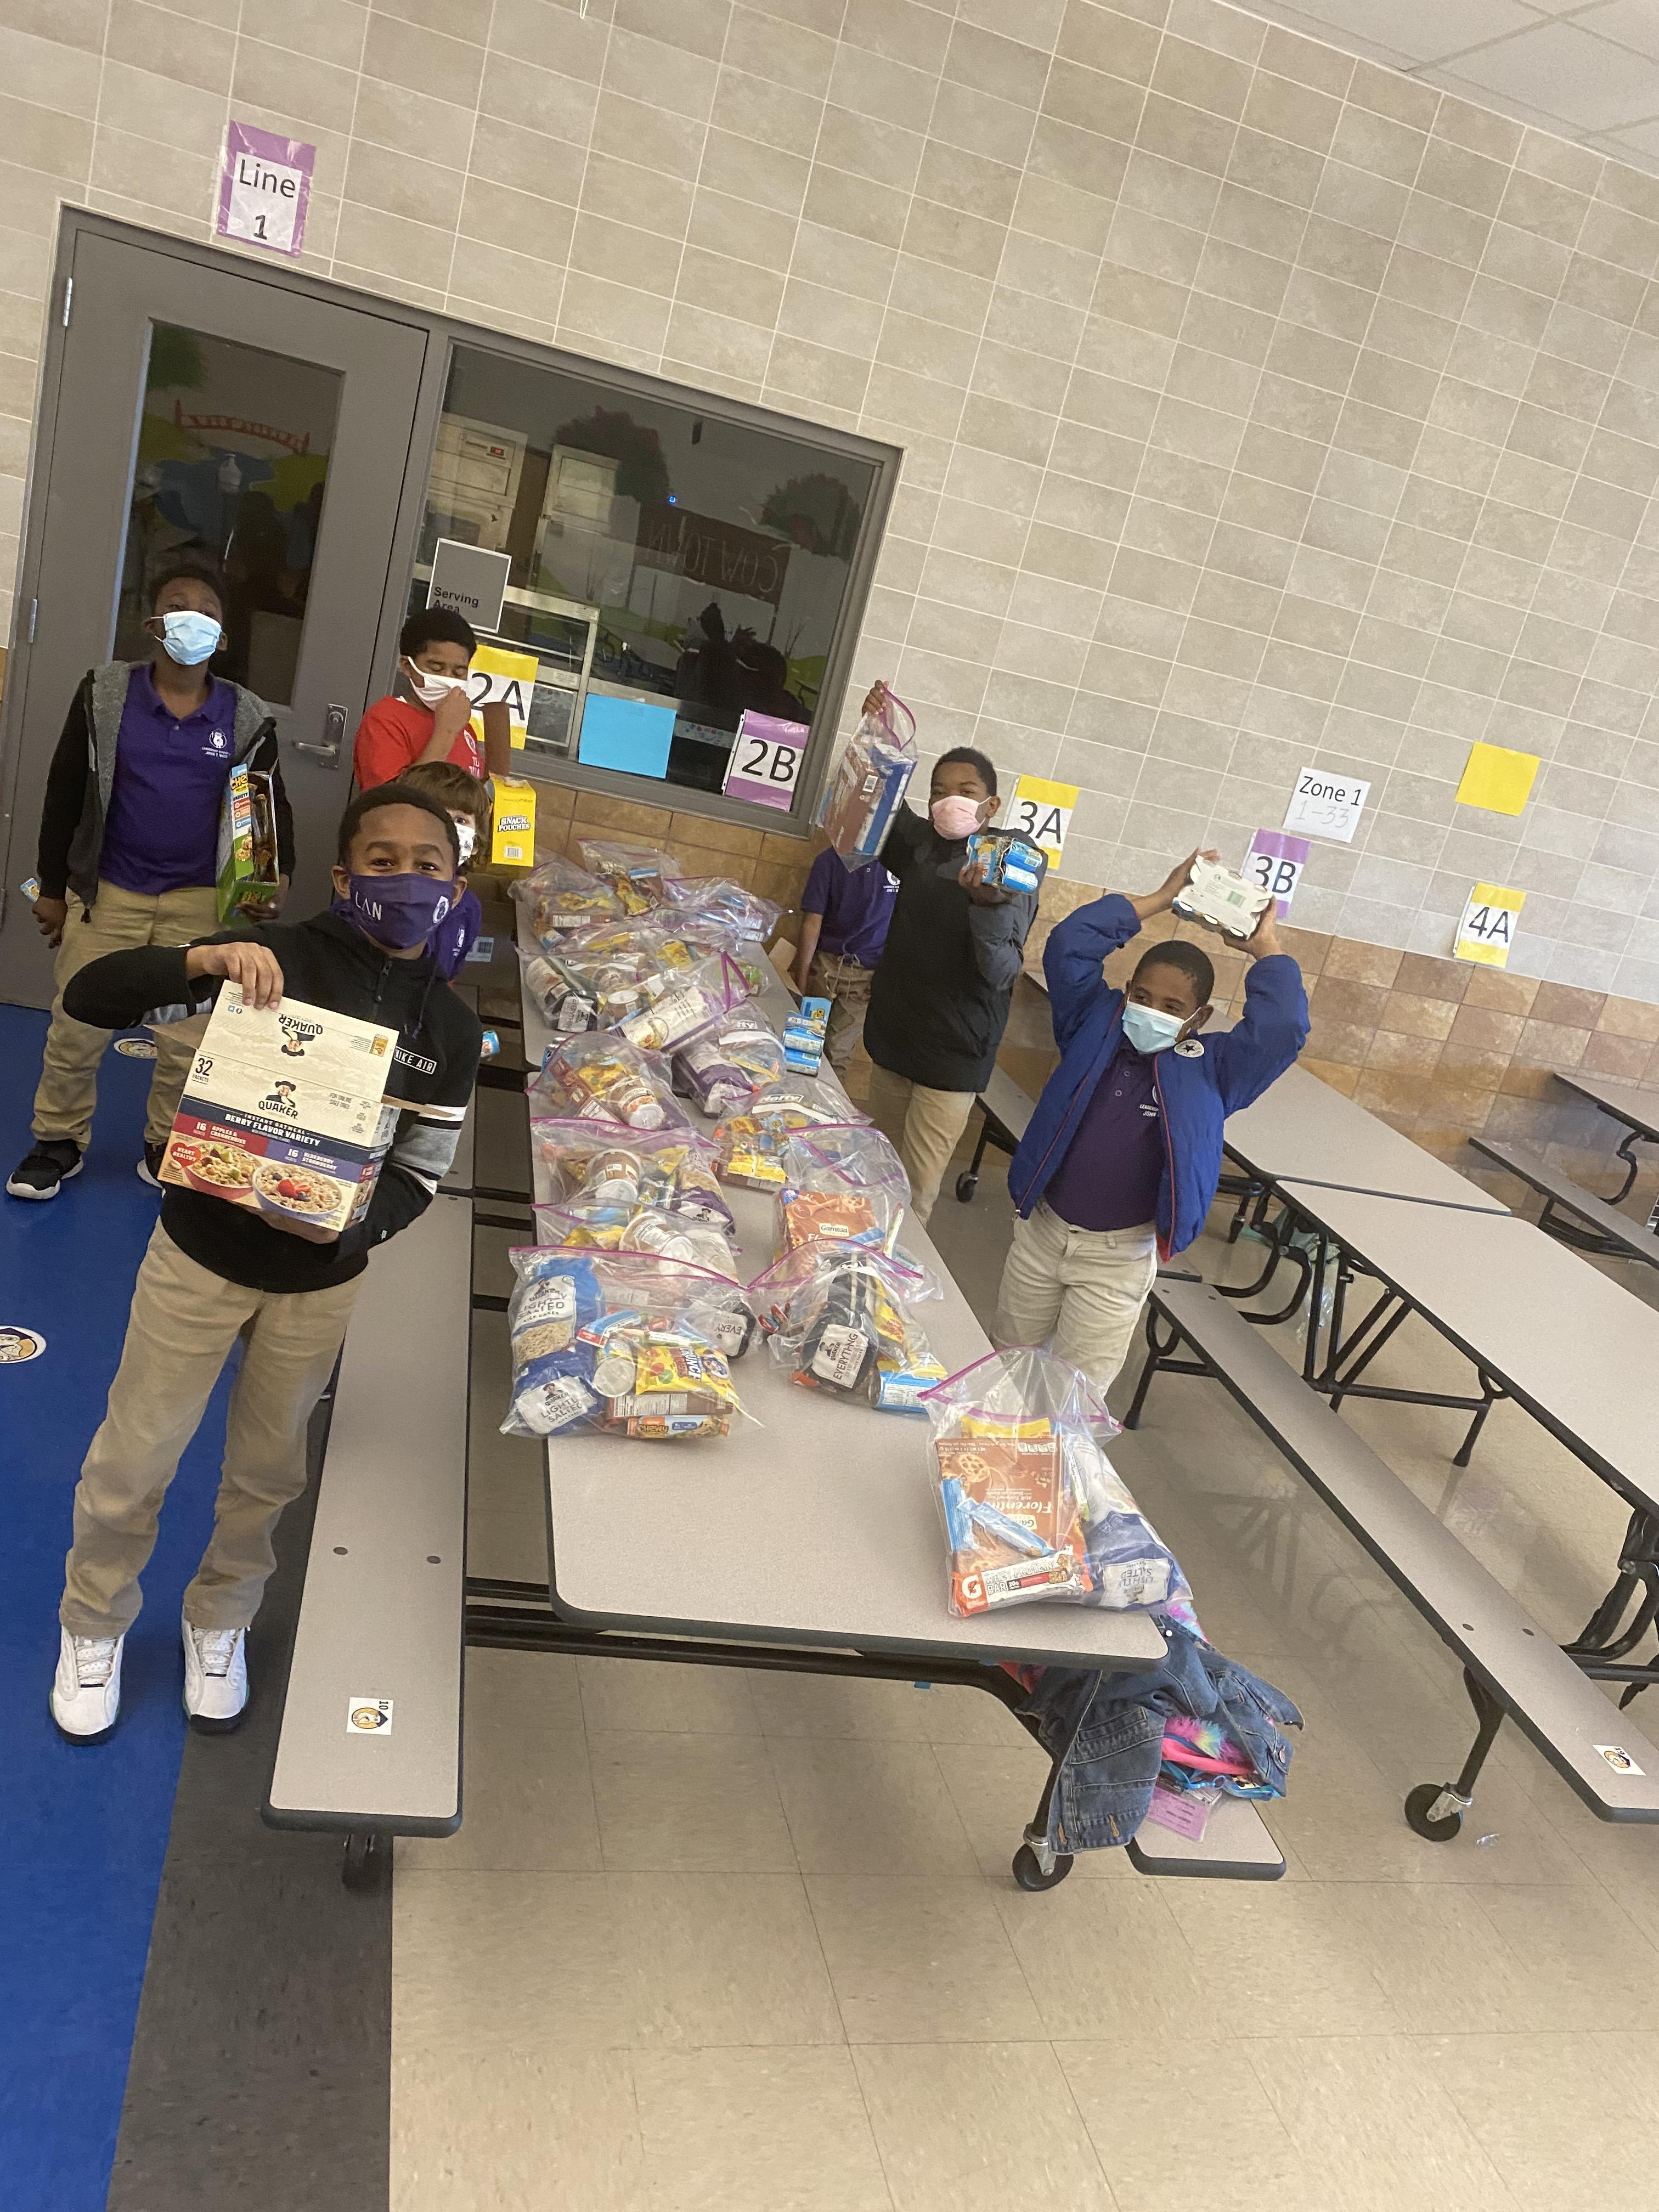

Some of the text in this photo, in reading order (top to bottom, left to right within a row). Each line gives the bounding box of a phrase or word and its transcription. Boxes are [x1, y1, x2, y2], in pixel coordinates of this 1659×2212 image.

[239, 159, 295, 198] Line
[253, 215, 267, 240] 1
[434, 586, 479, 608] Serving
[471, 673, 525, 720] 2A
[742, 739, 796, 782] 2B
[1299, 776, 1362, 806] Zone 1
[500, 817, 527, 825] SNACK
[1020, 801, 1062, 844] 3A
[1295, 800, 1350, 828] 1-33
[498, 823, 530, 832] POUCHES
[1255, 856, 1296, 894] 3B
[1469, 906, 1508, 943] 4A
[279, 1014, 323, 1035] QUAKER
[195, 1058, 213, 1076] 32
[395, 1048, 433, 1071] NIKE AIR
[192, 1074, 209, 1082] PACKETS
[258, 1101, 298, 1120] QUAKER
[196, 1121, 207, 1131] 16
[211, 1126, 232, 1135] APPLES
[225, 1114, 251, 1127] BERRY
[253, 1122, 284, 1137] FLAVOR
[285, 1130, 320, 1146] VARIETY
[244, 1113, 306, 1135] INSTANT OATMEAL
[210, 1131, 246, 1144] CRANBERRIES
[287, 1148, 298, 1158] 16
[821, 1225, 848, 1233] Gamesa
[833, 1333, 858, 1380] EVERYTHNG
[985, 1570, 1011, 1584] WHEY
[1014, 1564, 1053, 1578] PROTEIN
[962, 1574, 983, 1599] G
[988, 1582, 1007, 1595] BAR
[379, 1700, 389, 1710] 10
